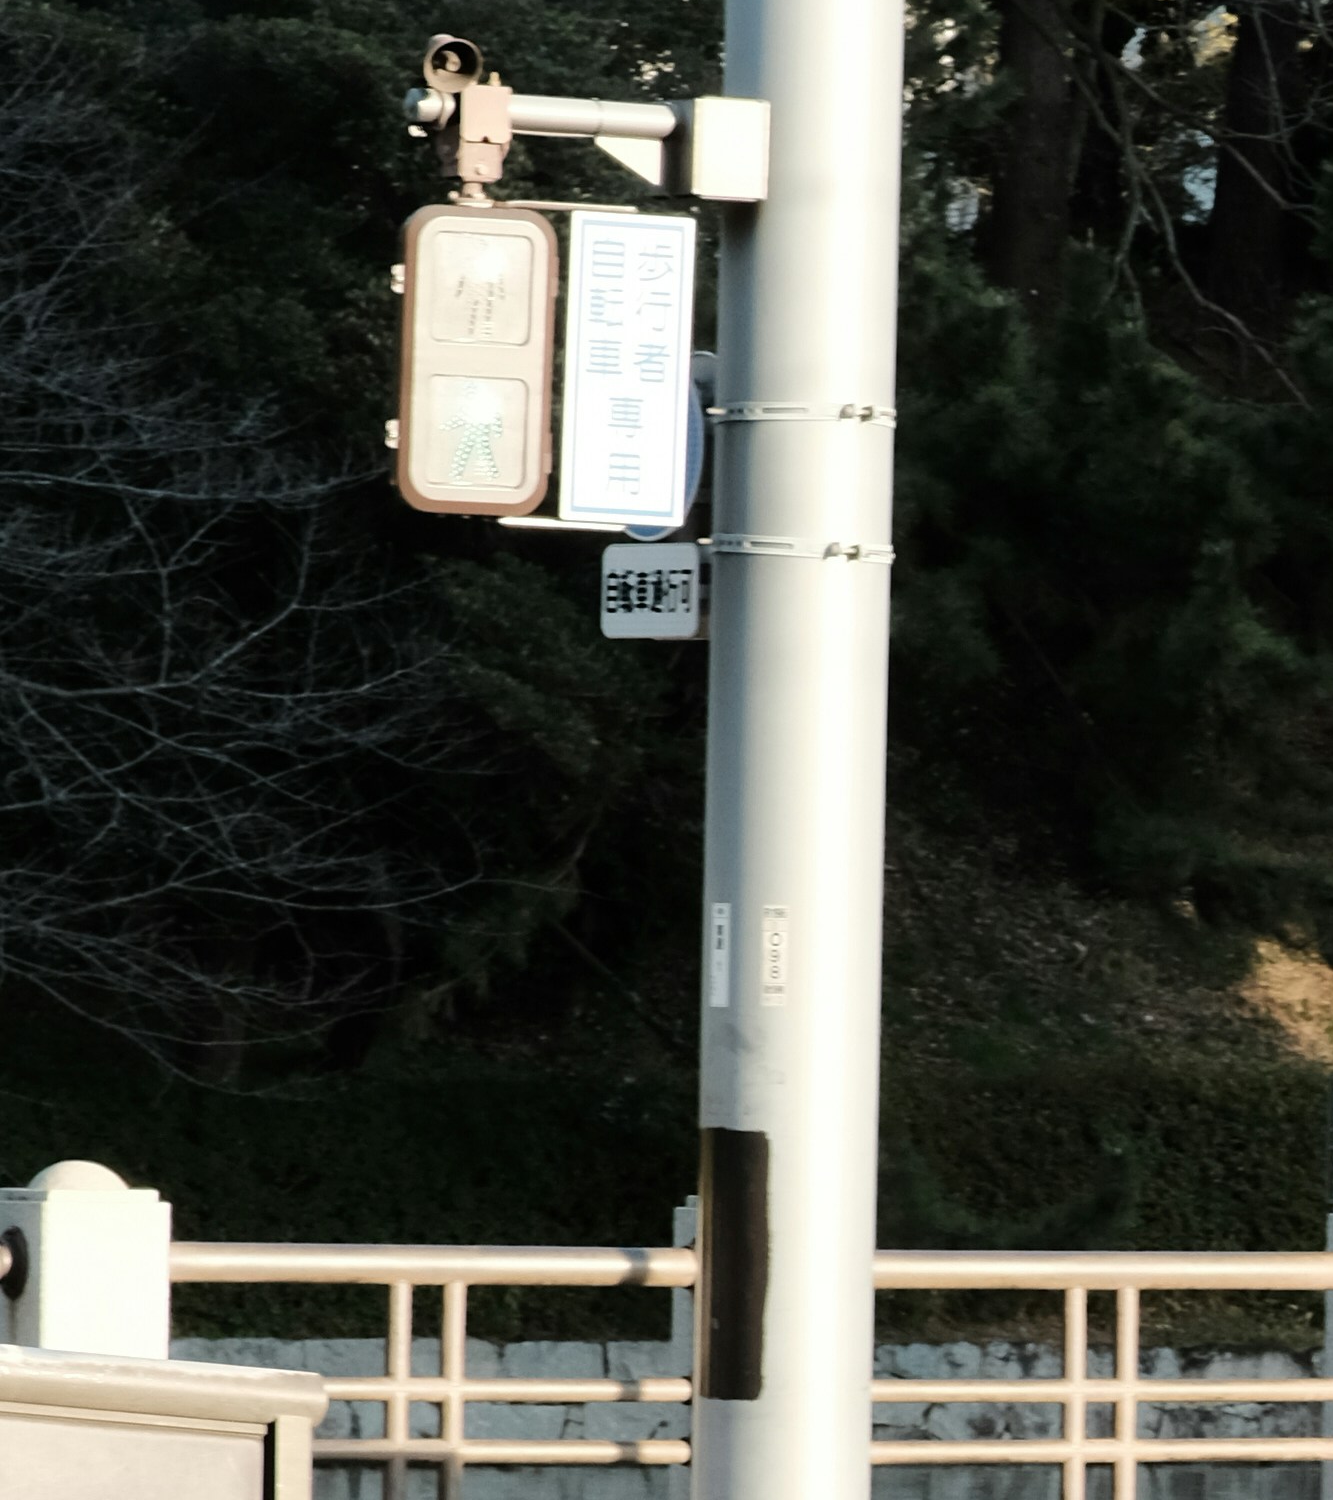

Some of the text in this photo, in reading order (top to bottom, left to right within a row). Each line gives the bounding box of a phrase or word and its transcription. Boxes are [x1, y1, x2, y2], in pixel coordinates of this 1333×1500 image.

[585, 238, 626, 376] 自転車
[633, 243, 675, 384] 歩行者
[606, 396, 645, 496] 専用
